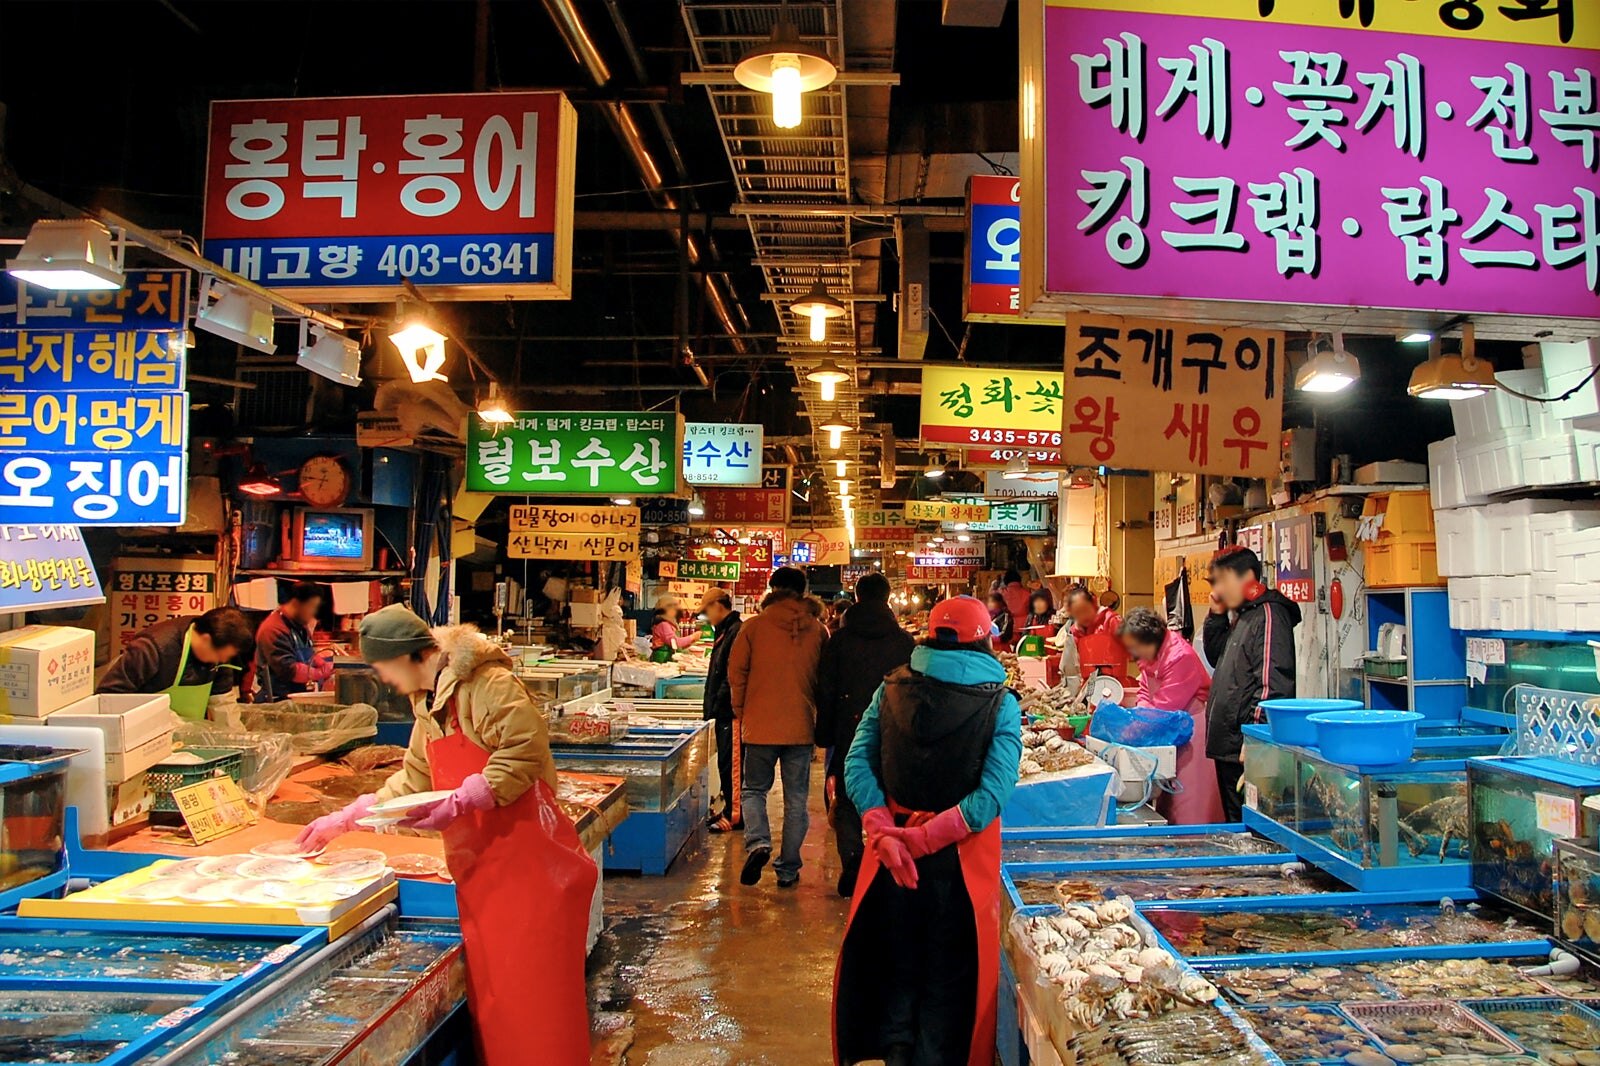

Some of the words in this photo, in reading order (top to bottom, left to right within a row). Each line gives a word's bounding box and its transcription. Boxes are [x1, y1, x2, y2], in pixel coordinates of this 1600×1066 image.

[224, 111, 539, 221] 홍탁·홍어
[221, 244, 363, 281] 내고향
[377, 242, 539, 277] 403-6341
[1074, 325, 1275, 400] 조개구이
[478, 437, 667, 487] 털보수산
[0, 455, 181, 520] 오징어
[513, 506, 575, 529] 민물장어
[590, 513, 637, 528] 아나고
[584, 537, 634, 557] 산문어
[119, 573, 208, 592] 영산포상회
